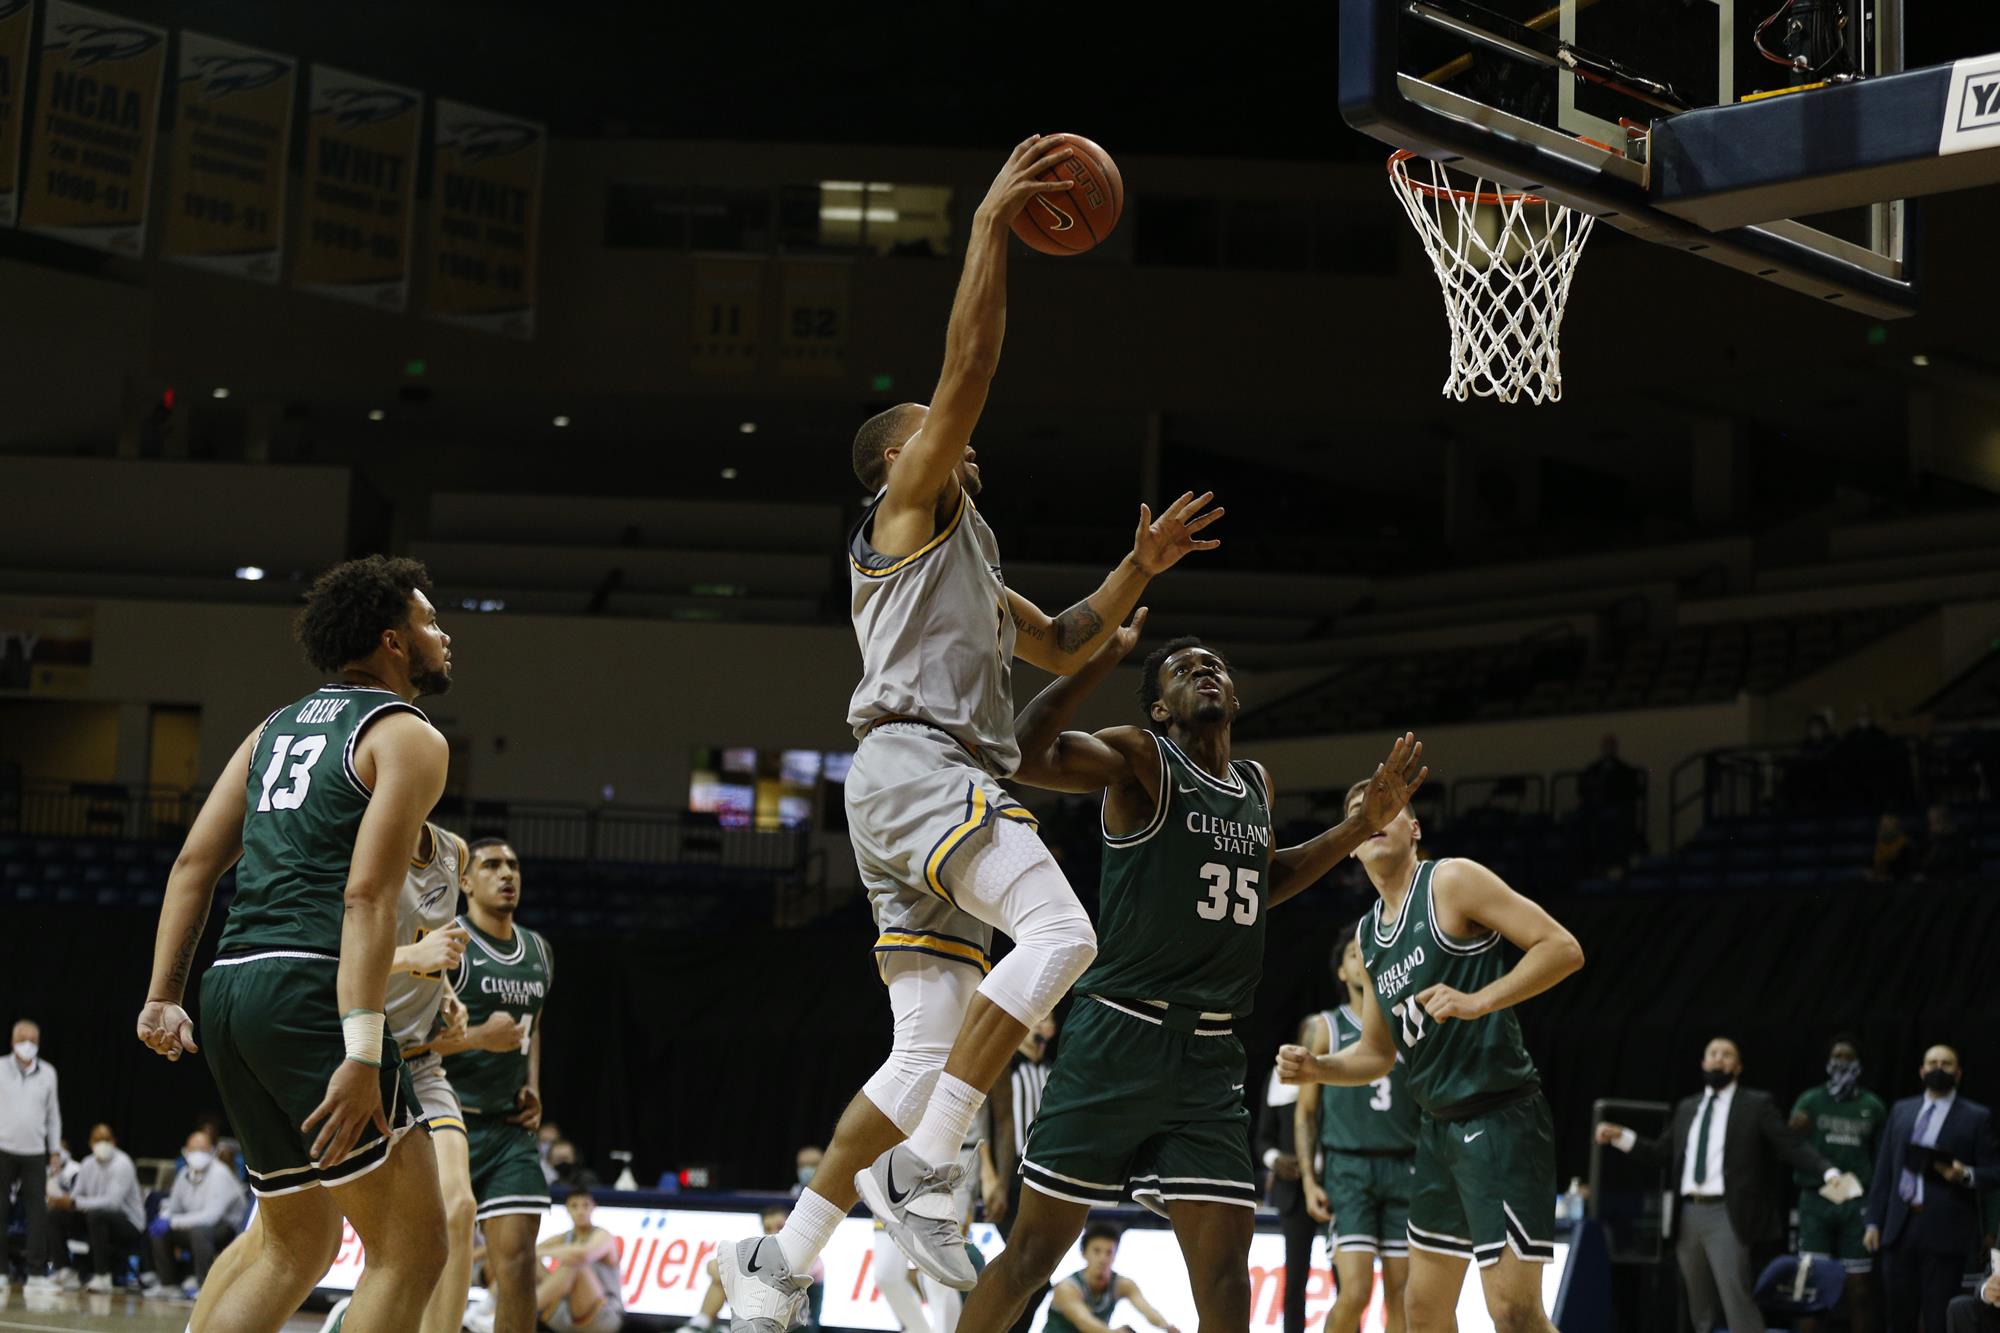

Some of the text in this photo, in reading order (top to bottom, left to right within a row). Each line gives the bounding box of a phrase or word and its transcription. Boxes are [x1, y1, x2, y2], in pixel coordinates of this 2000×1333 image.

[53, 70, 141, 130] NCAA
[1064, 157, 1104, 209] ELITE
[792, 307, 838, 337] 52
[296, 698, 350, 724] GREENE
[256, 733, 328, 812] 13
[1186, 811, 1270, 848] CLEVELAND
[1213, 835, 1257, 857] STATE
[1195, 860, 1260, 927] 35
[481, 976, 545, 999] CLEVELAND
[501, 992, 530, 1006] STATE
[1386, 972, 1412, 999] STATE
[1368, 1075, 1393, 1112] 3
[612, 1214, 717, 1306] ijer
